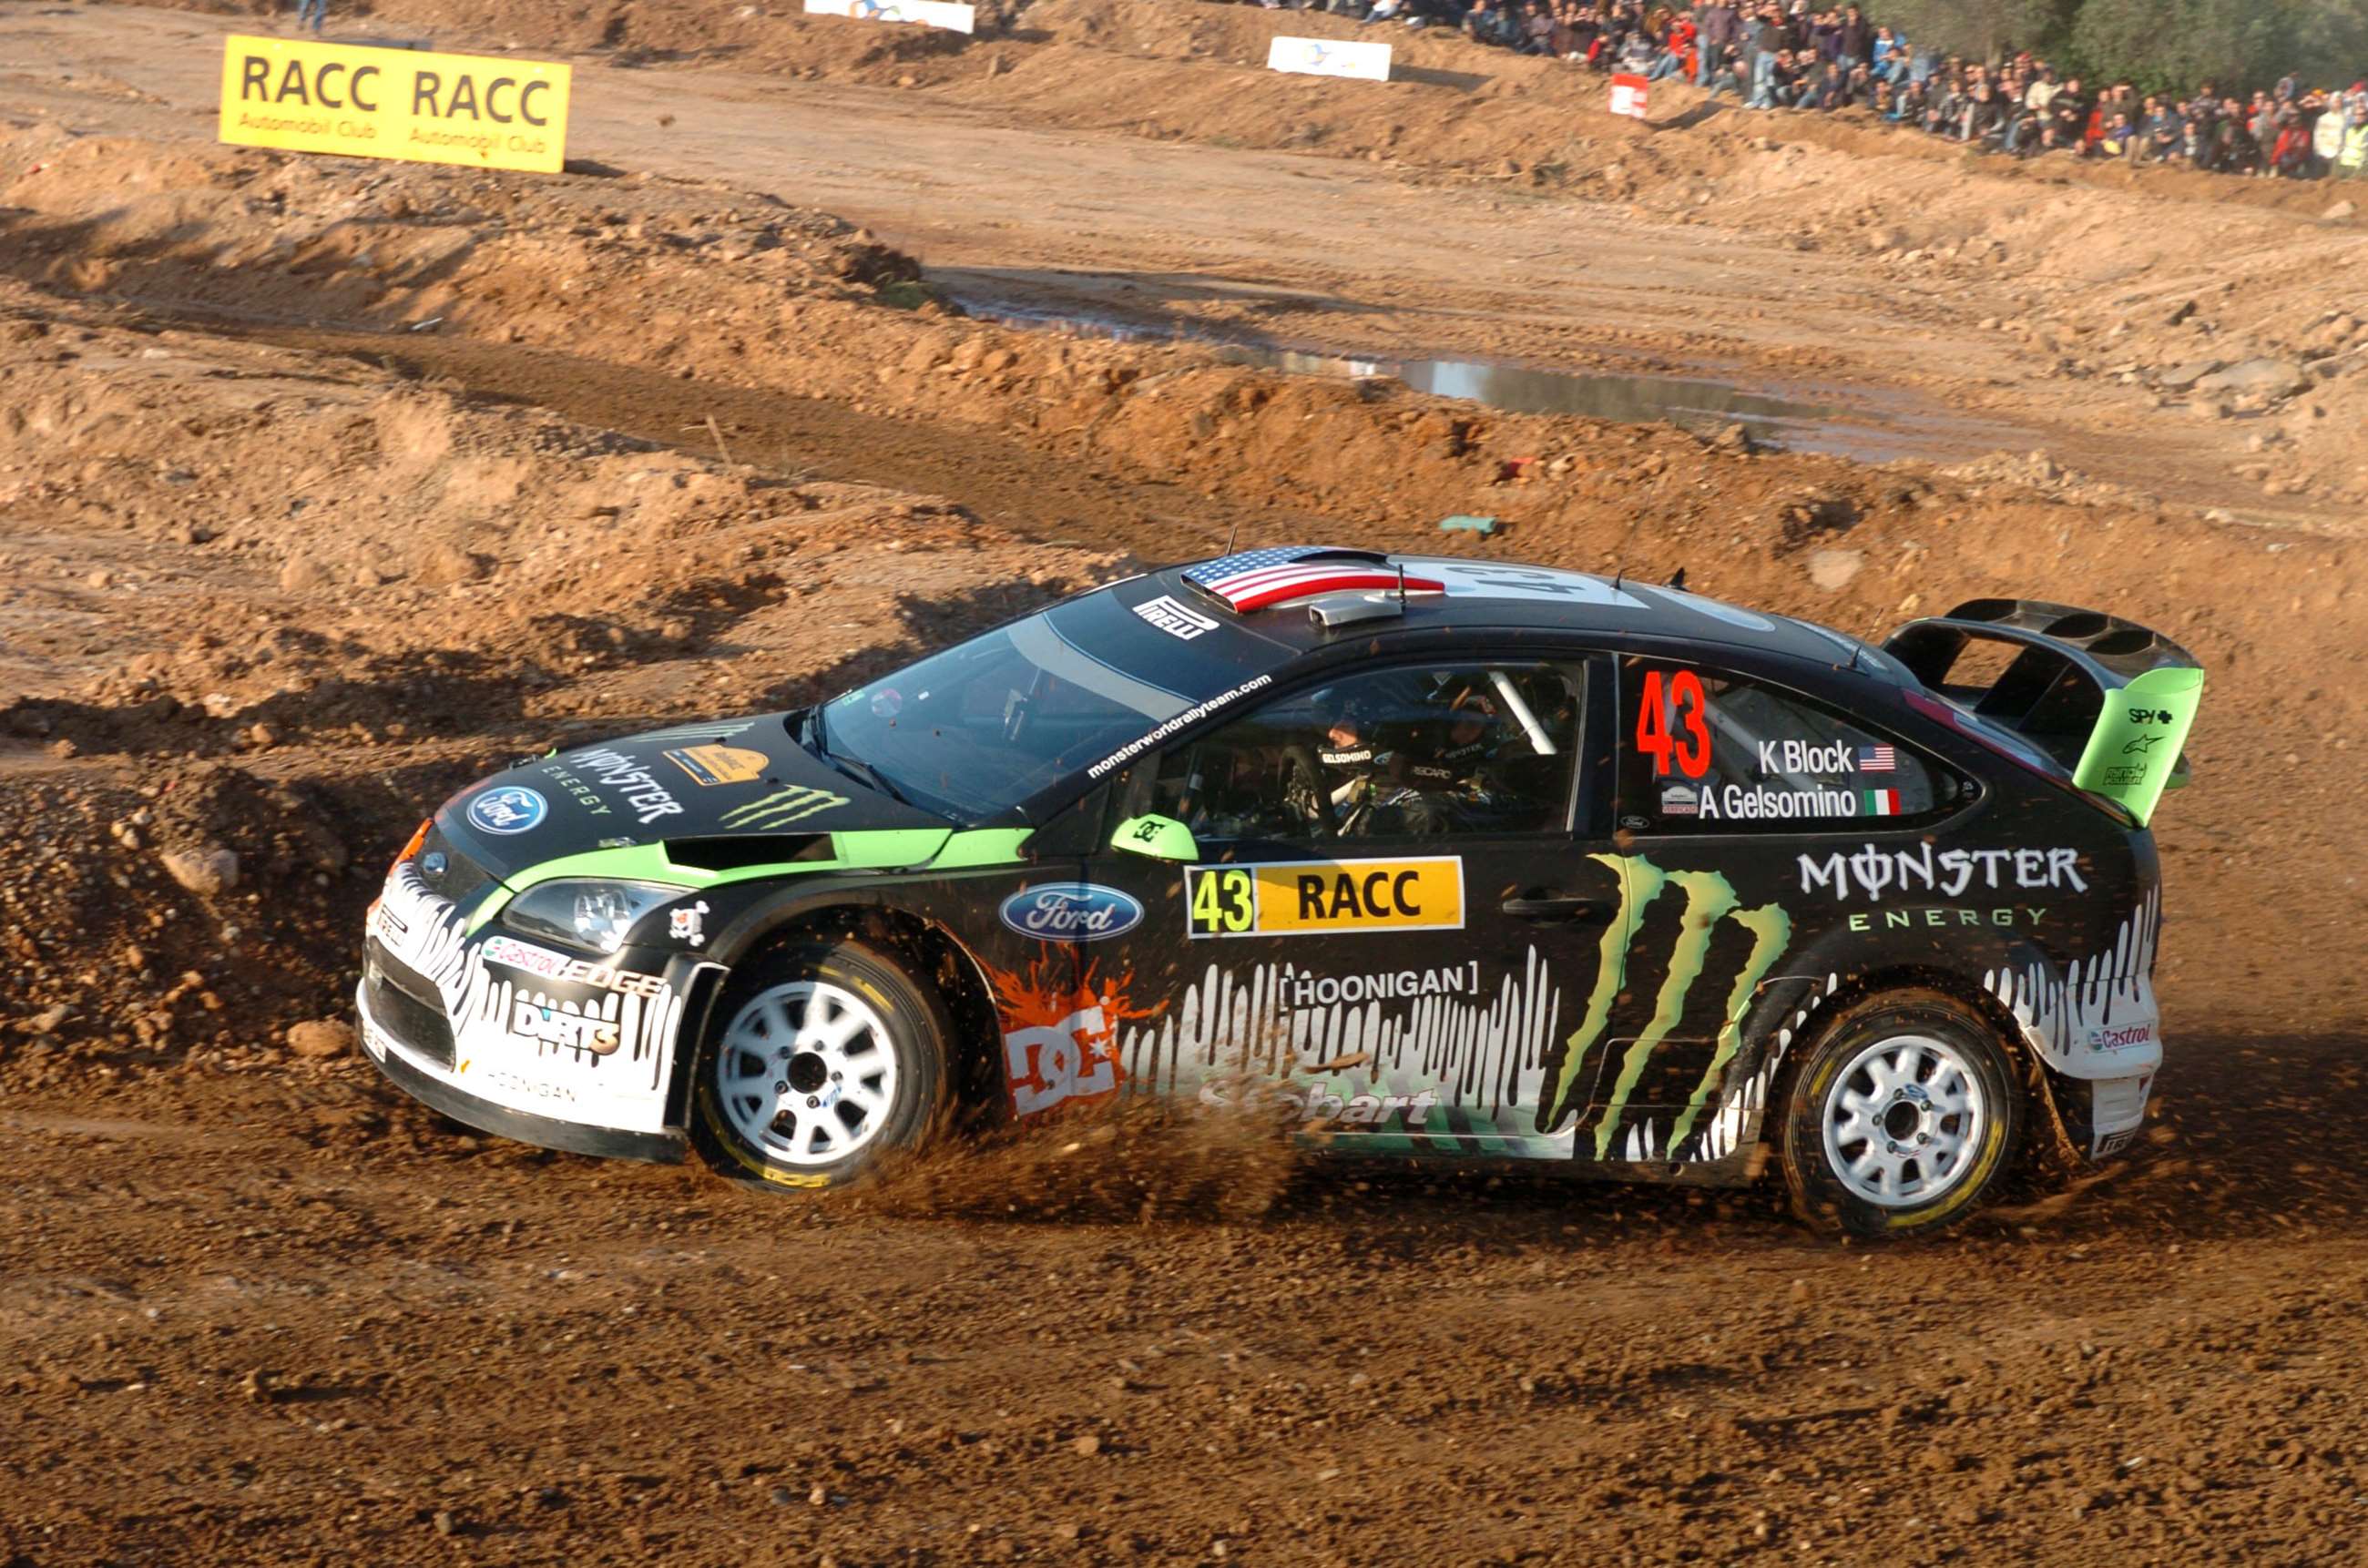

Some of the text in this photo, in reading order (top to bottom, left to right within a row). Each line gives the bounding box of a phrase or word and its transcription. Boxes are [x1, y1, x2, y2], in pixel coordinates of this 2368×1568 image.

[241, 55, 382, 112] RACC
[412, 70, 550, 127] RACC
[239, 112, 377, 139] Automobil Club
[409, 127, 546, 154] Automobil Club
[1132, 594, 1220, 640] PIRELLI
[1087, 673, 1272, 779] monsterworldrallyteam.com
[1636, 670, 1711, 779] 43
[1759, 739, 1854, 774] K Block
[476, 790, 530, 828] Ford
[539, 766, 614, 818] ENERGY
[568, 748, 685, 825] MONSTER
[1699, 784, 1856, 819] A Gelsomino
[1797, 840, 2087, 901] MONSTER
[1026, 896, 1116, 930] Ford
[1192, 870, 1421, 932] 43 RACC
[1850, 909, 2046, 932] ENERGY
[497, 942, 668, 999] Castrol EDGE
[1005, 1005, 1114, 1116] DC
[2101, 1023, 2150, 1049] Castrol
